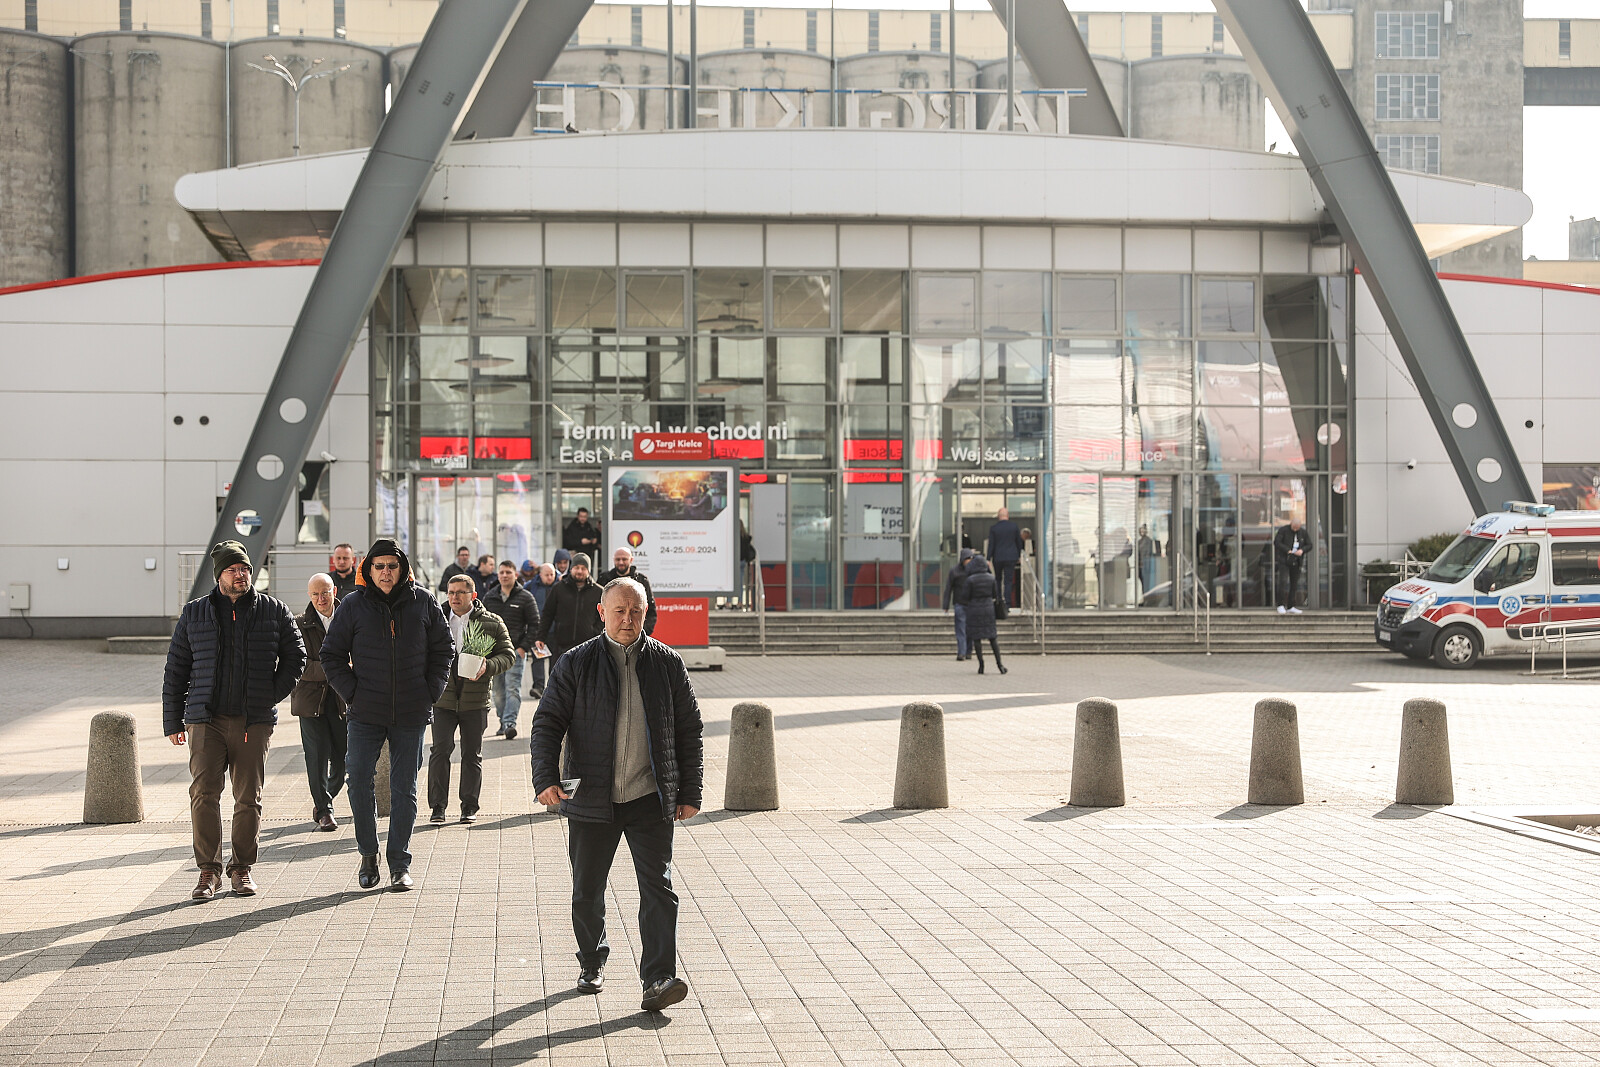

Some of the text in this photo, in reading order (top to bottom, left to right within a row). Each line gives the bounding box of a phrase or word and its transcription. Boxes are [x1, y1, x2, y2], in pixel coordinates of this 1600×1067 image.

[656, 439, 703, 450] Targi Kielce
[559, 446, 603, 463] East
[950, 447, 1016, 465] Wejście
[660, 546, 717, 554] 24-25.09.2024
[656, 604, 703, 612] .targikielce.pl
